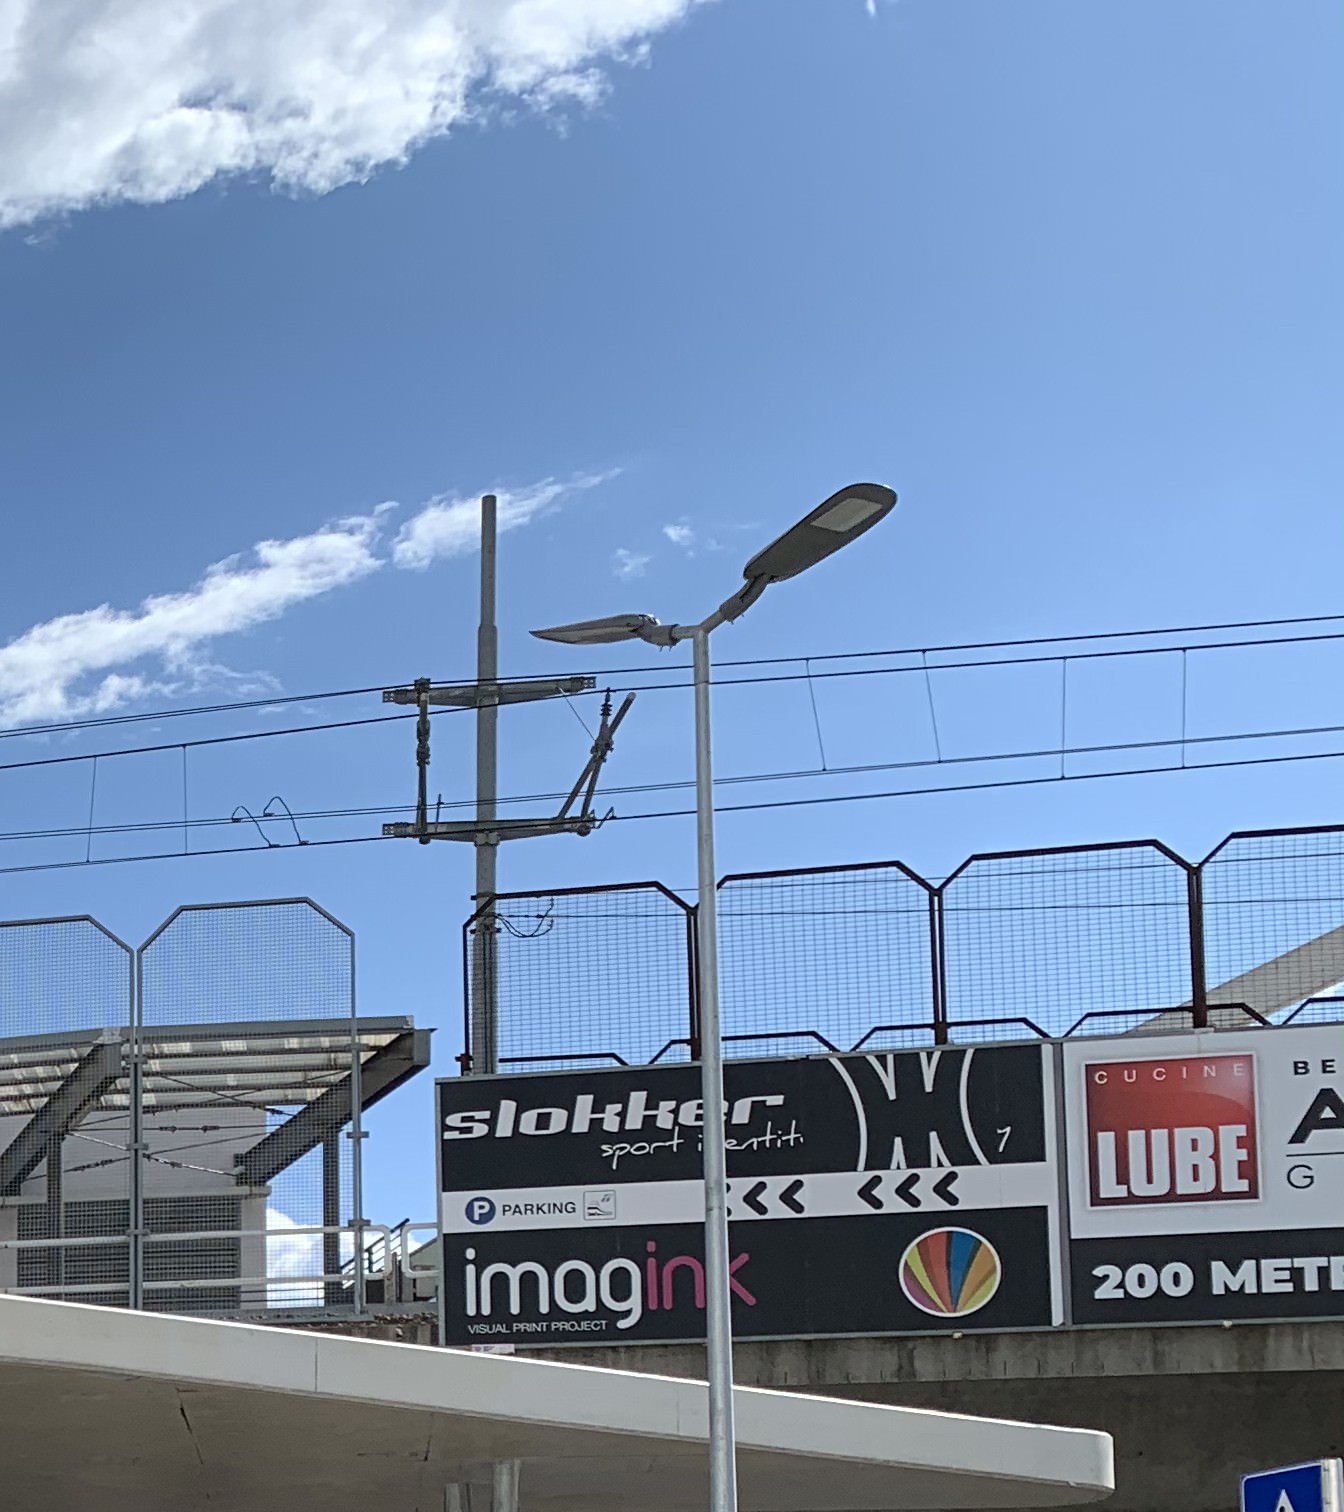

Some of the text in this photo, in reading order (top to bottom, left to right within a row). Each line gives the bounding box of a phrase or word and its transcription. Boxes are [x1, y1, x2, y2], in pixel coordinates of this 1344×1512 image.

[1094, 1063, 1246, 1085] CUCINE
[443, 1091, 785, 1140] slokker
[600, 1126, 685, 1170] sport
[1097, 1124, 1250, 1199] LUBE
[502, 1202, 577, 1217] PARKING
[1091, 1261, 1195, 1300] 200
[468, 1320, 608, 1335] VISUAL PRINT PROJECT
